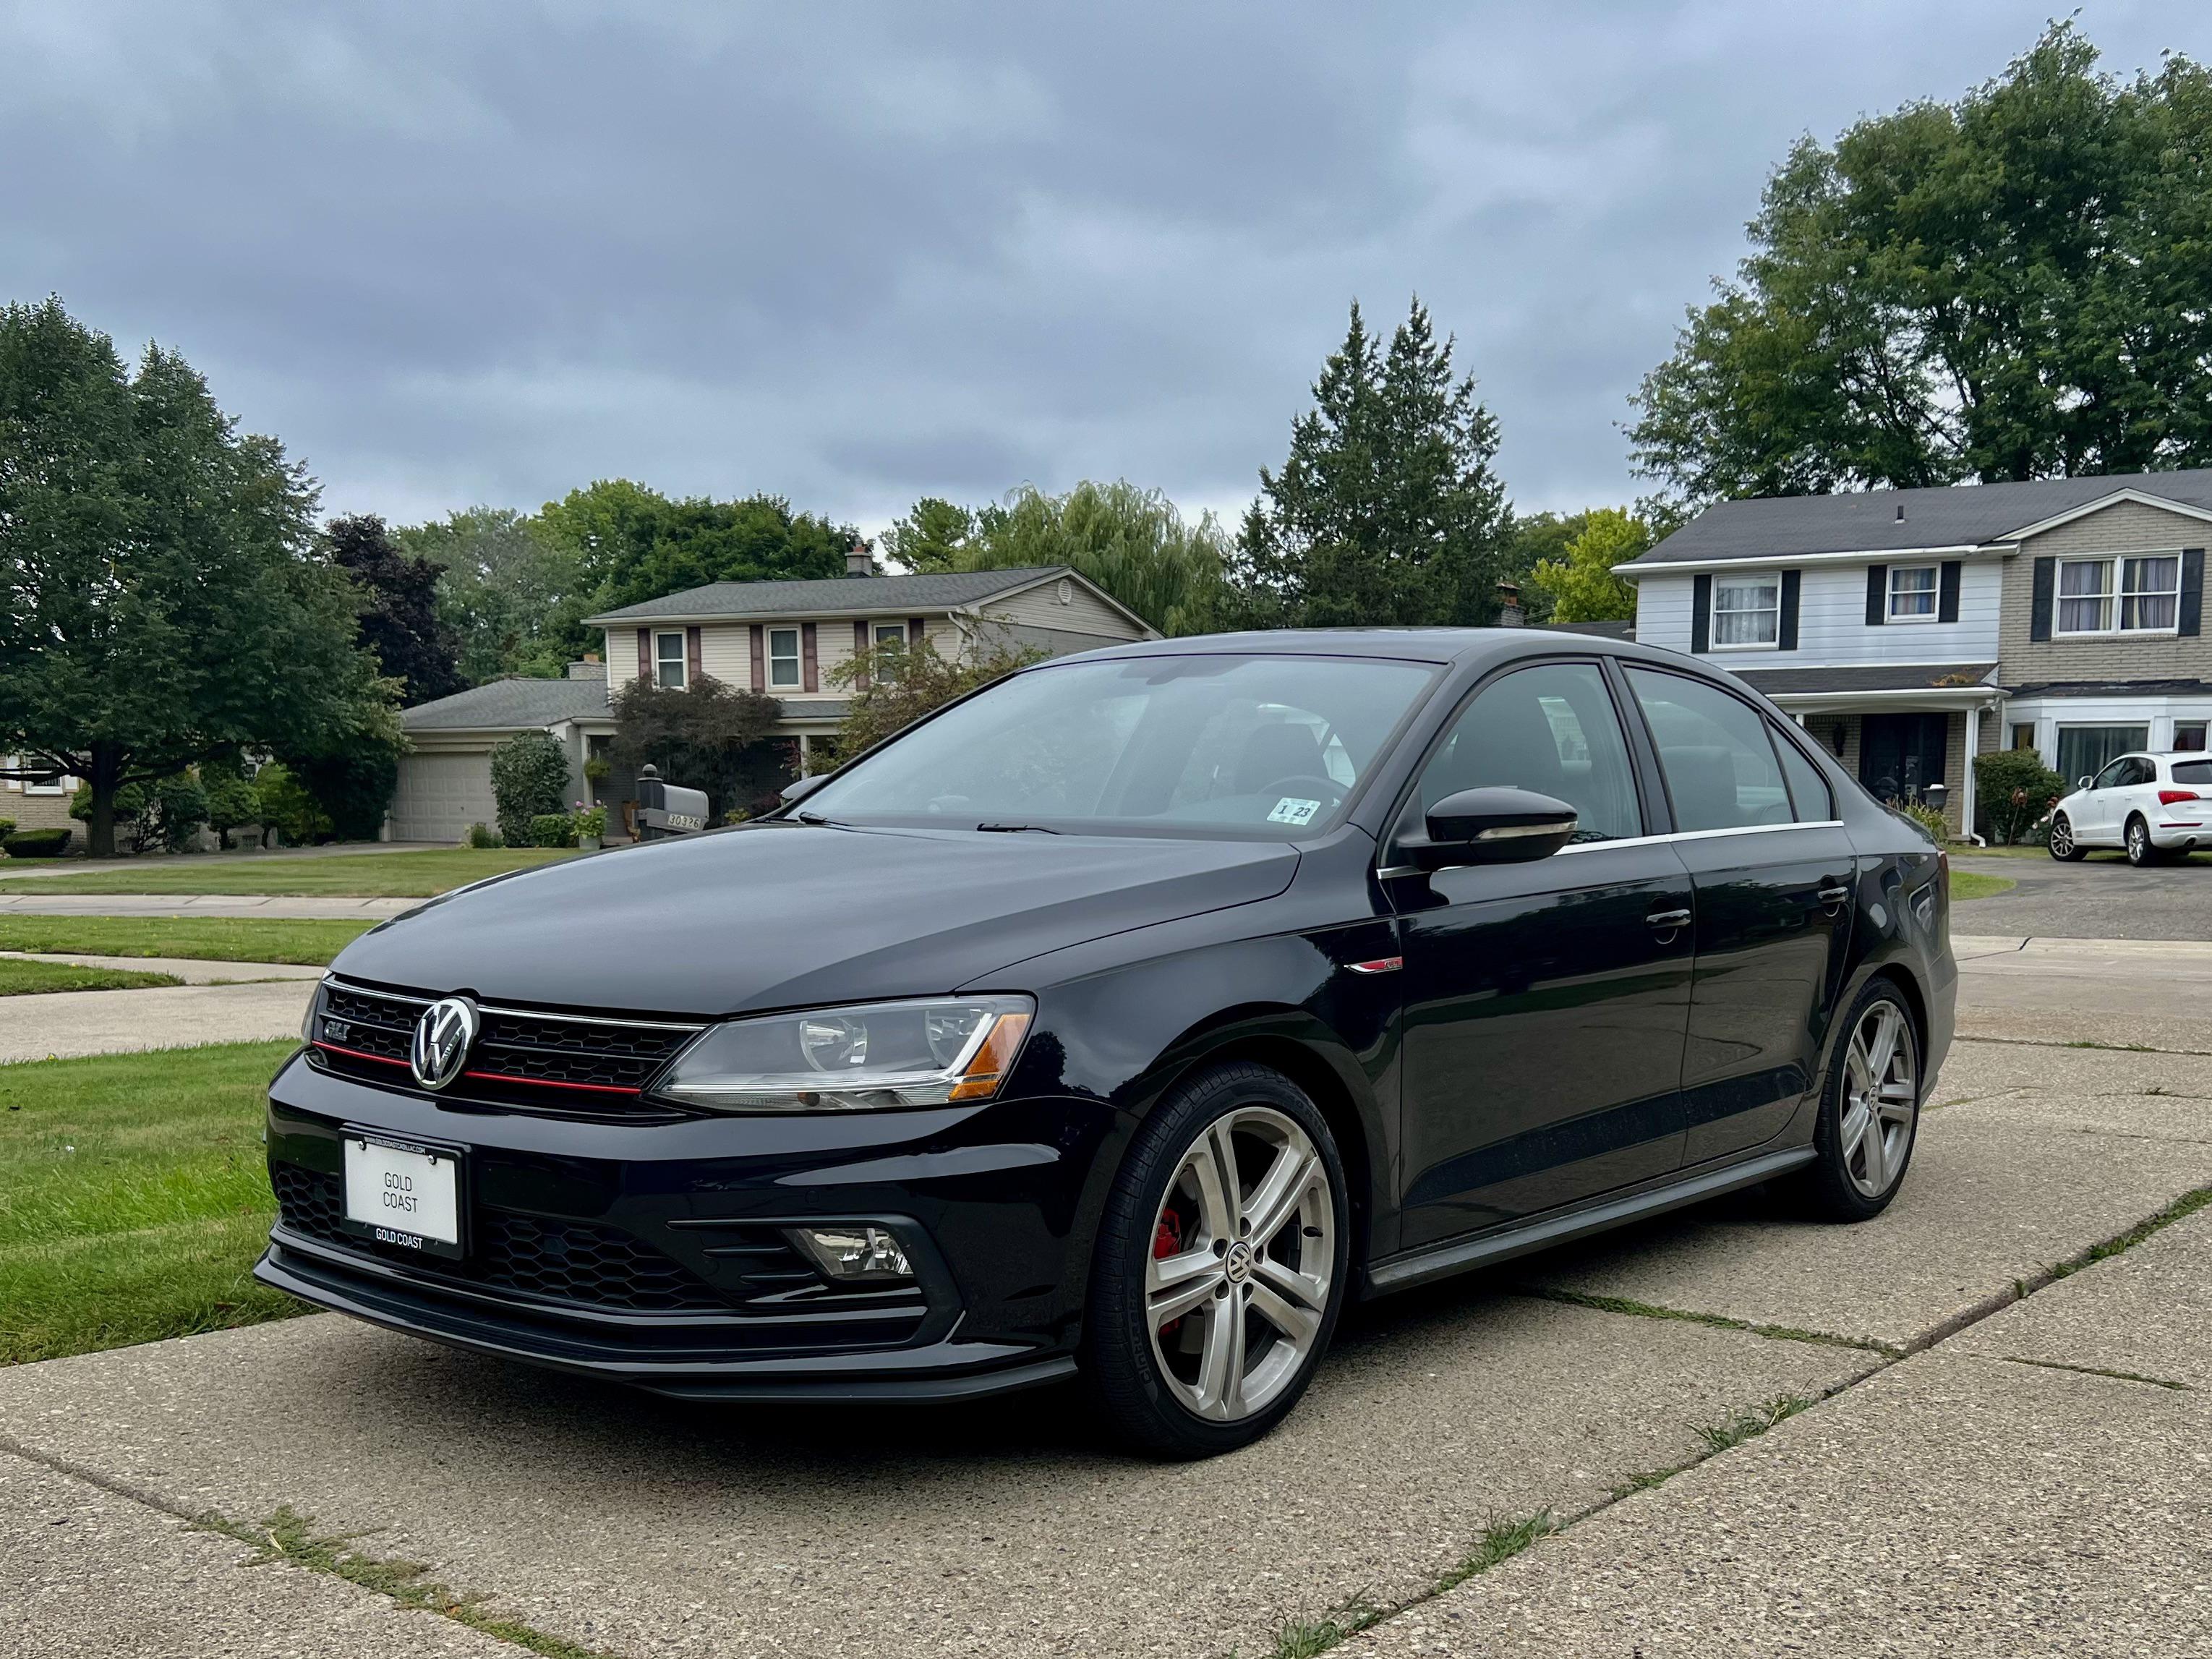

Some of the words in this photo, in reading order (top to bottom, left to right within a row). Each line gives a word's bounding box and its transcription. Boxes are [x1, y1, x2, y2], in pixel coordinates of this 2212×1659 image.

[1278, 805, 1288, 814] 1
[1293, 807, 1310, 817] 23
[385, 1172, 412, 1192] GOLD
[383, 1192, 418, 1213] COAST
[376, 1228, 396, 1243] GOLD
[397, 1232, 423, 1250] COAST
